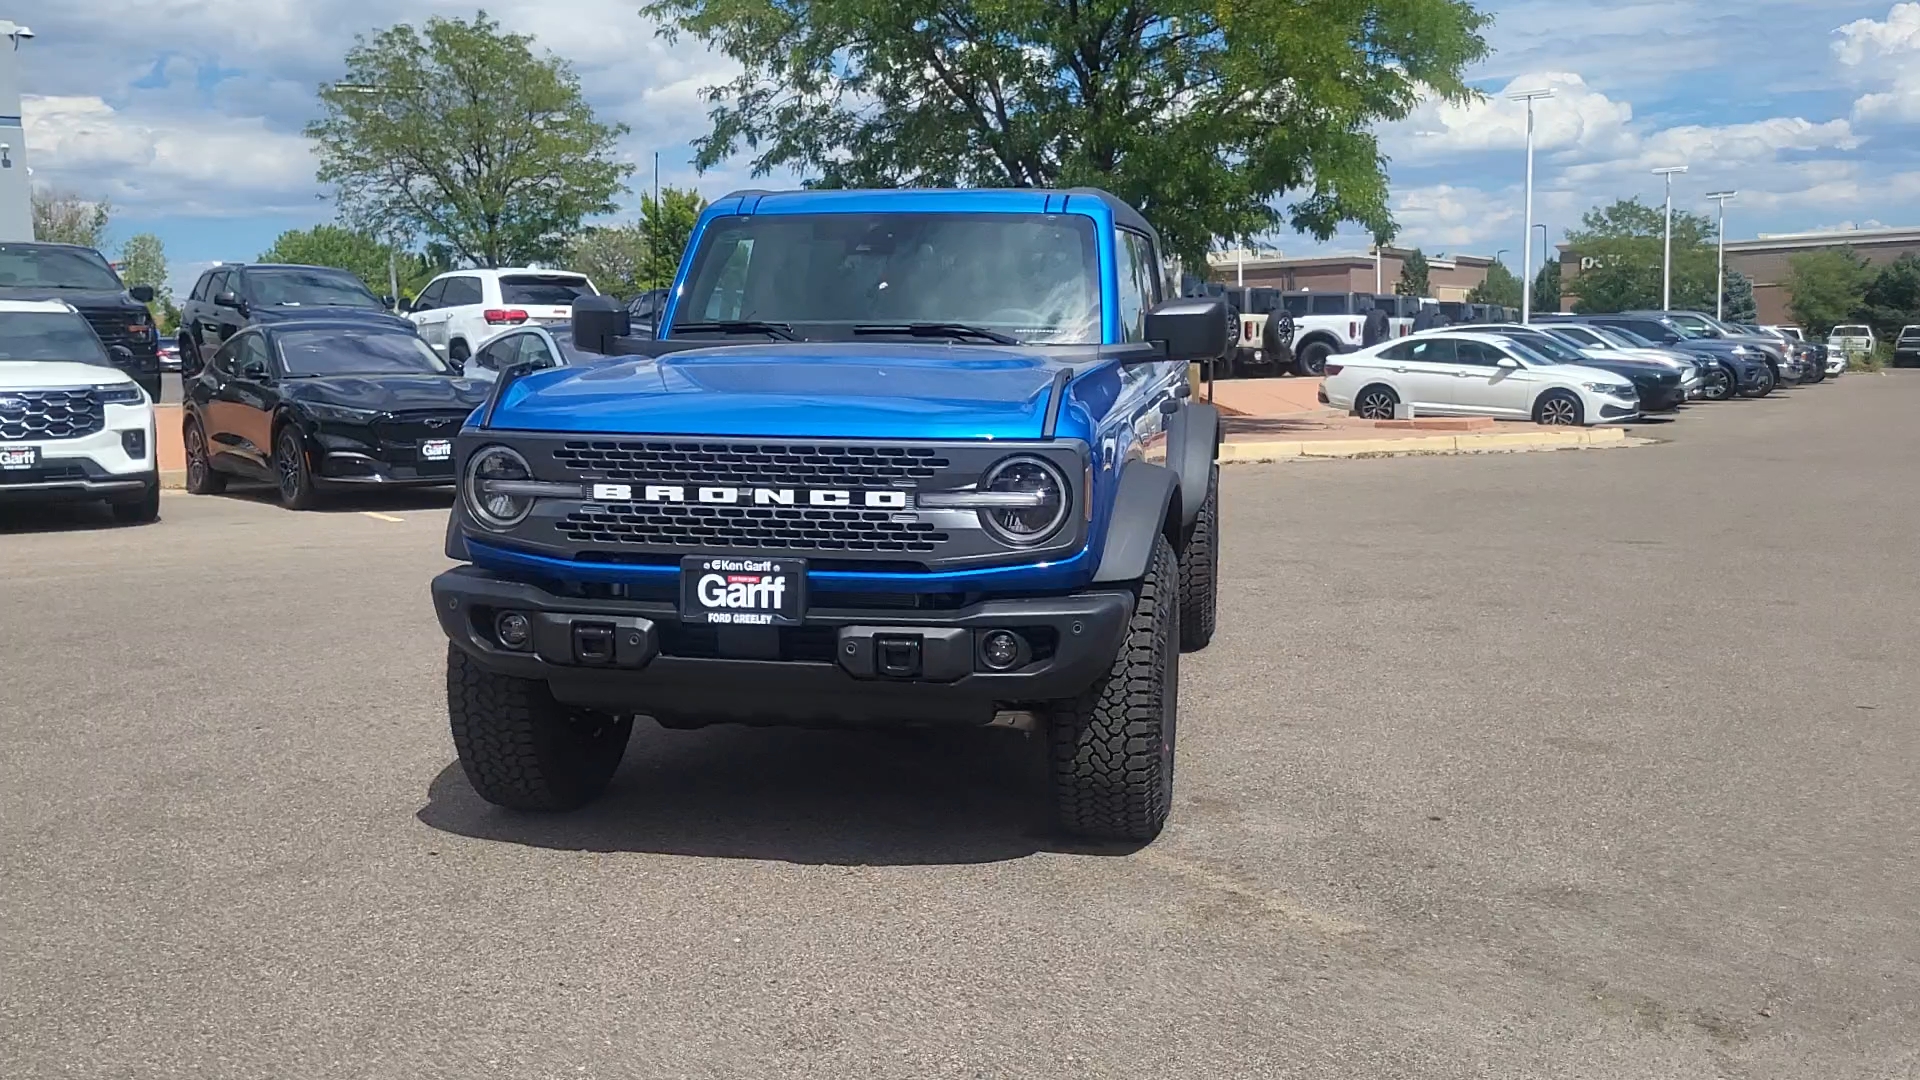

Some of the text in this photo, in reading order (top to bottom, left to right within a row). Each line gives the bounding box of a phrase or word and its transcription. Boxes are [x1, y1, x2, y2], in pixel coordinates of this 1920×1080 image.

[593, 484, 906, 507] BRONCO
[721, 560, 771, 572] Ken Garff
[697, 573, 785, 609] Garff
[708, 613, 772, 624] FORD GREELEY
